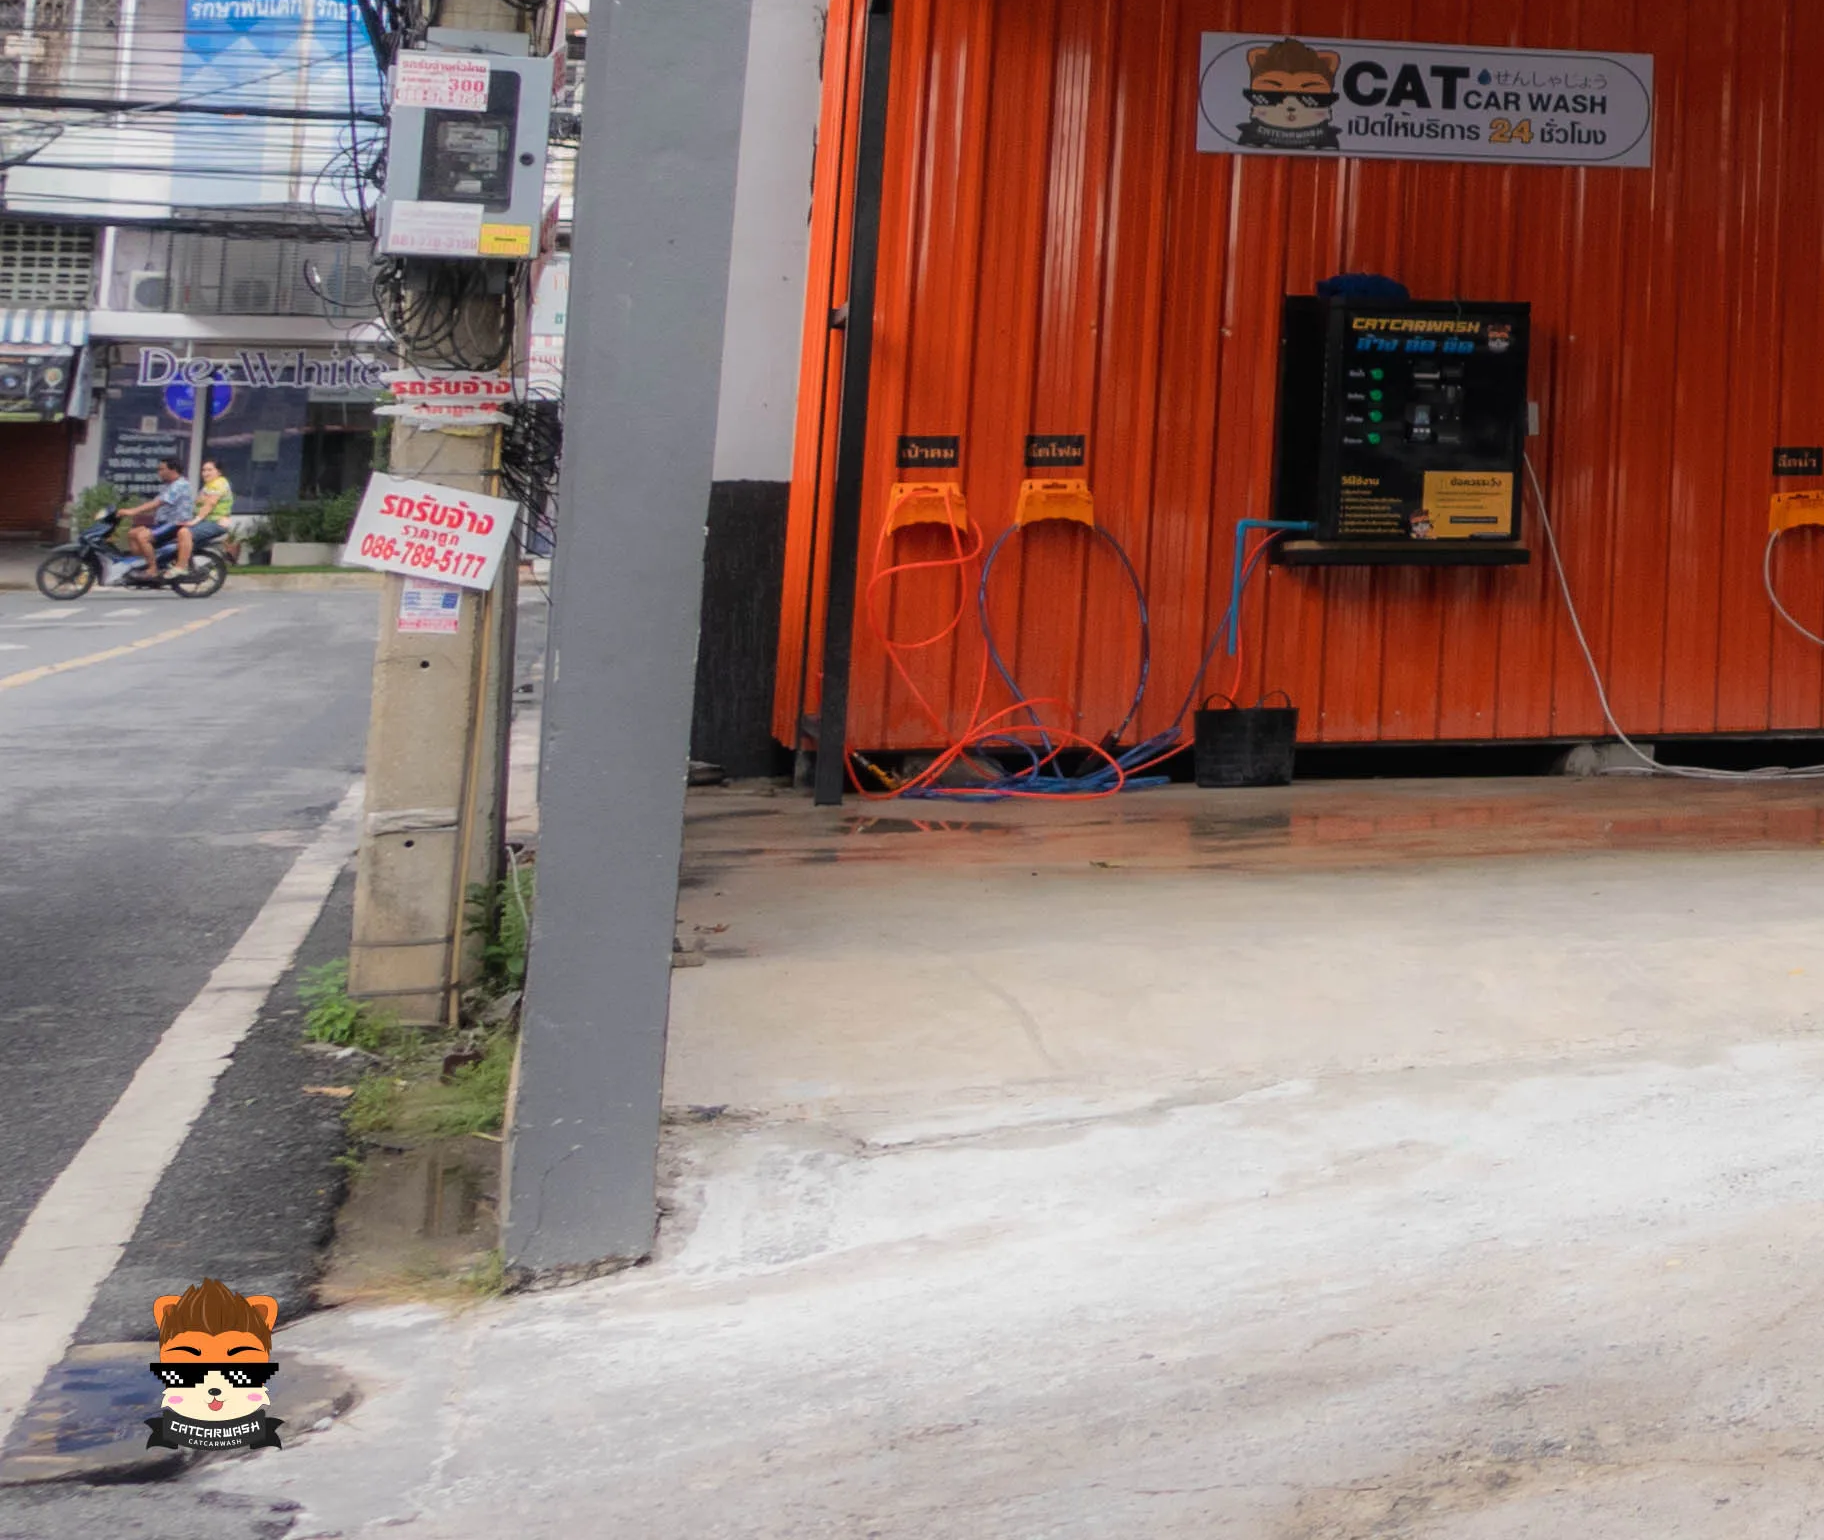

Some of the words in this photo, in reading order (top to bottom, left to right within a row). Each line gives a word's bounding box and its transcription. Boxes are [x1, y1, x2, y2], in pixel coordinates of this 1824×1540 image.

[1342, 60, 1470, 110] CAT
[1463, 90, 1521, 113] CAR
[1529, 93, 1607, 115] WASH
[1347, 112, 1481, 143] เปิดให้บริการ
[1487, 116, 1534, 145] 24
[1540, 116, 1607, 146] ชั่วโมง
[1352, 317, 1481, 334] CATCARWASH
[137, 346, 215, 387] De
[391, 377, 512, 396] รถรับจ้าง
[379, 494, 496, 536] รถรับจ้าง
[360, 532, 487, 579] 086-789-5177
